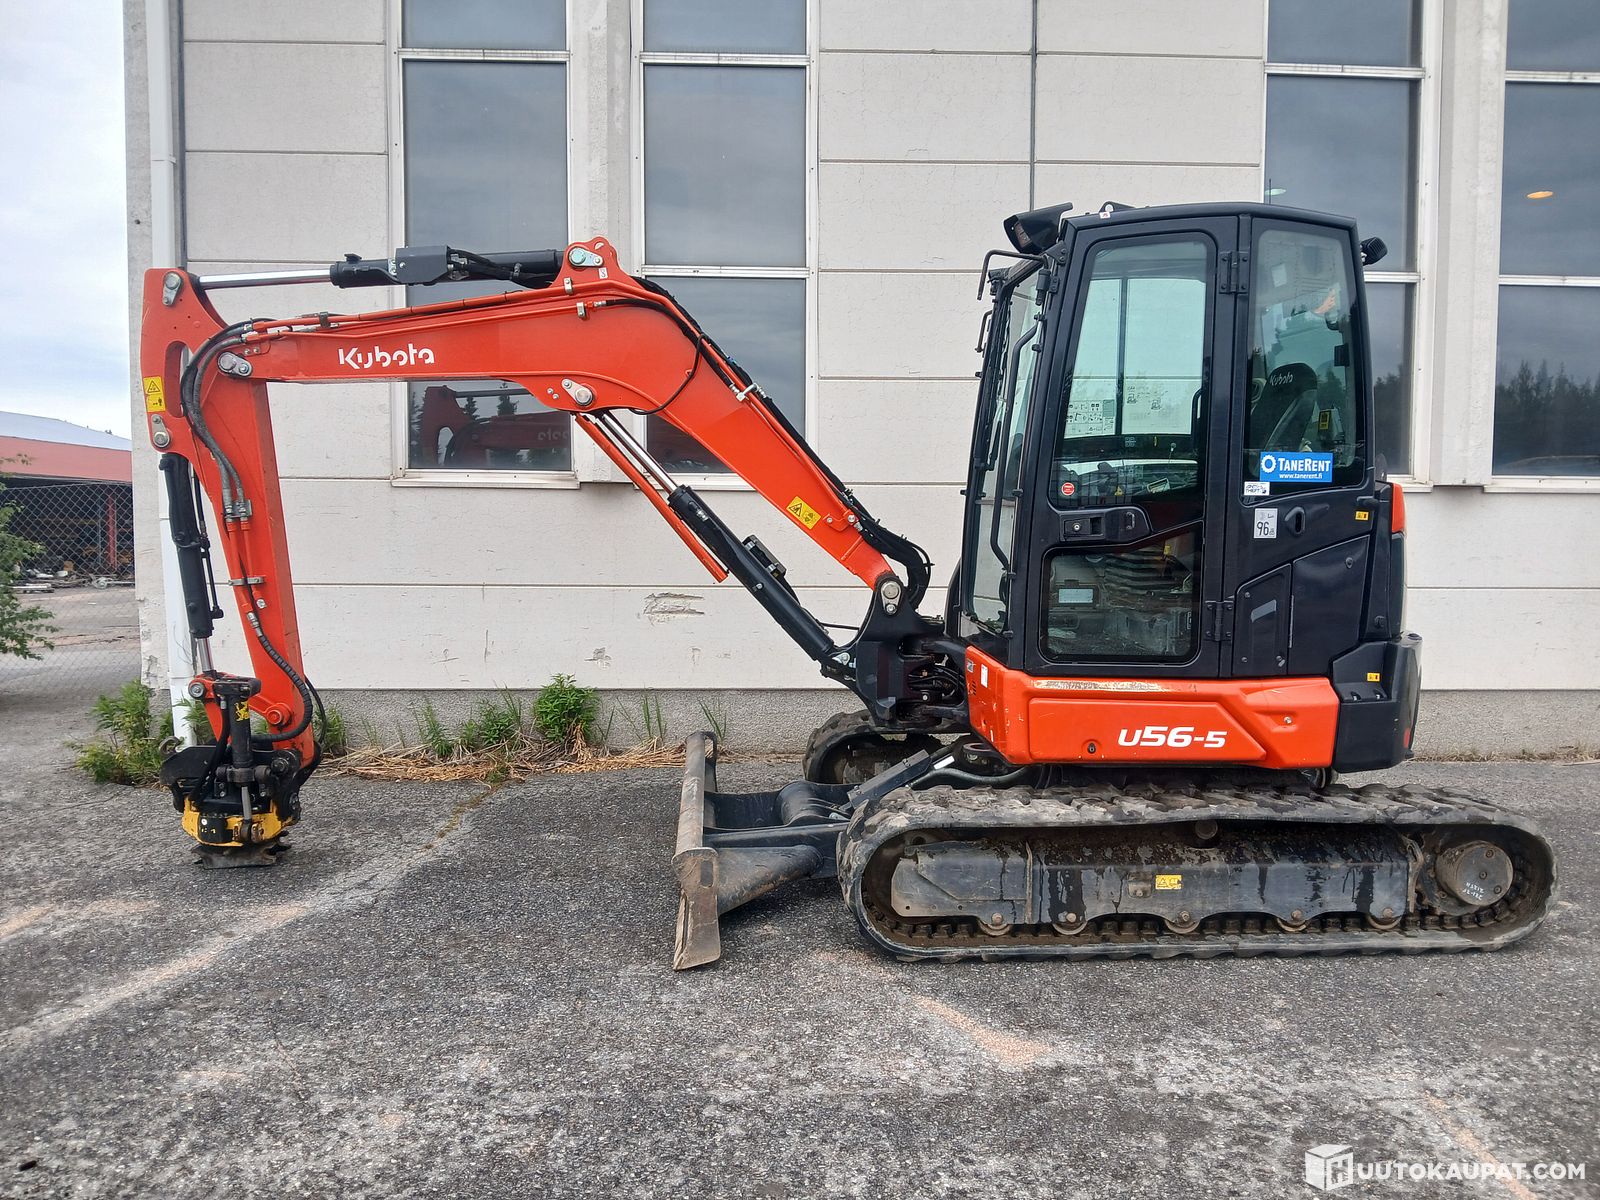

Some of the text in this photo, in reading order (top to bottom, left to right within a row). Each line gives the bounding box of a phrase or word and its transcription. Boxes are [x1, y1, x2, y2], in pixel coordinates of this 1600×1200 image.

[338, 343, 435, 369] Kubota
[1270, 372, 1293, 386] Kubota
[1279, 472, 1323, 480] www.tanerent.fi
[1256, 521, 1270, 536] 96
